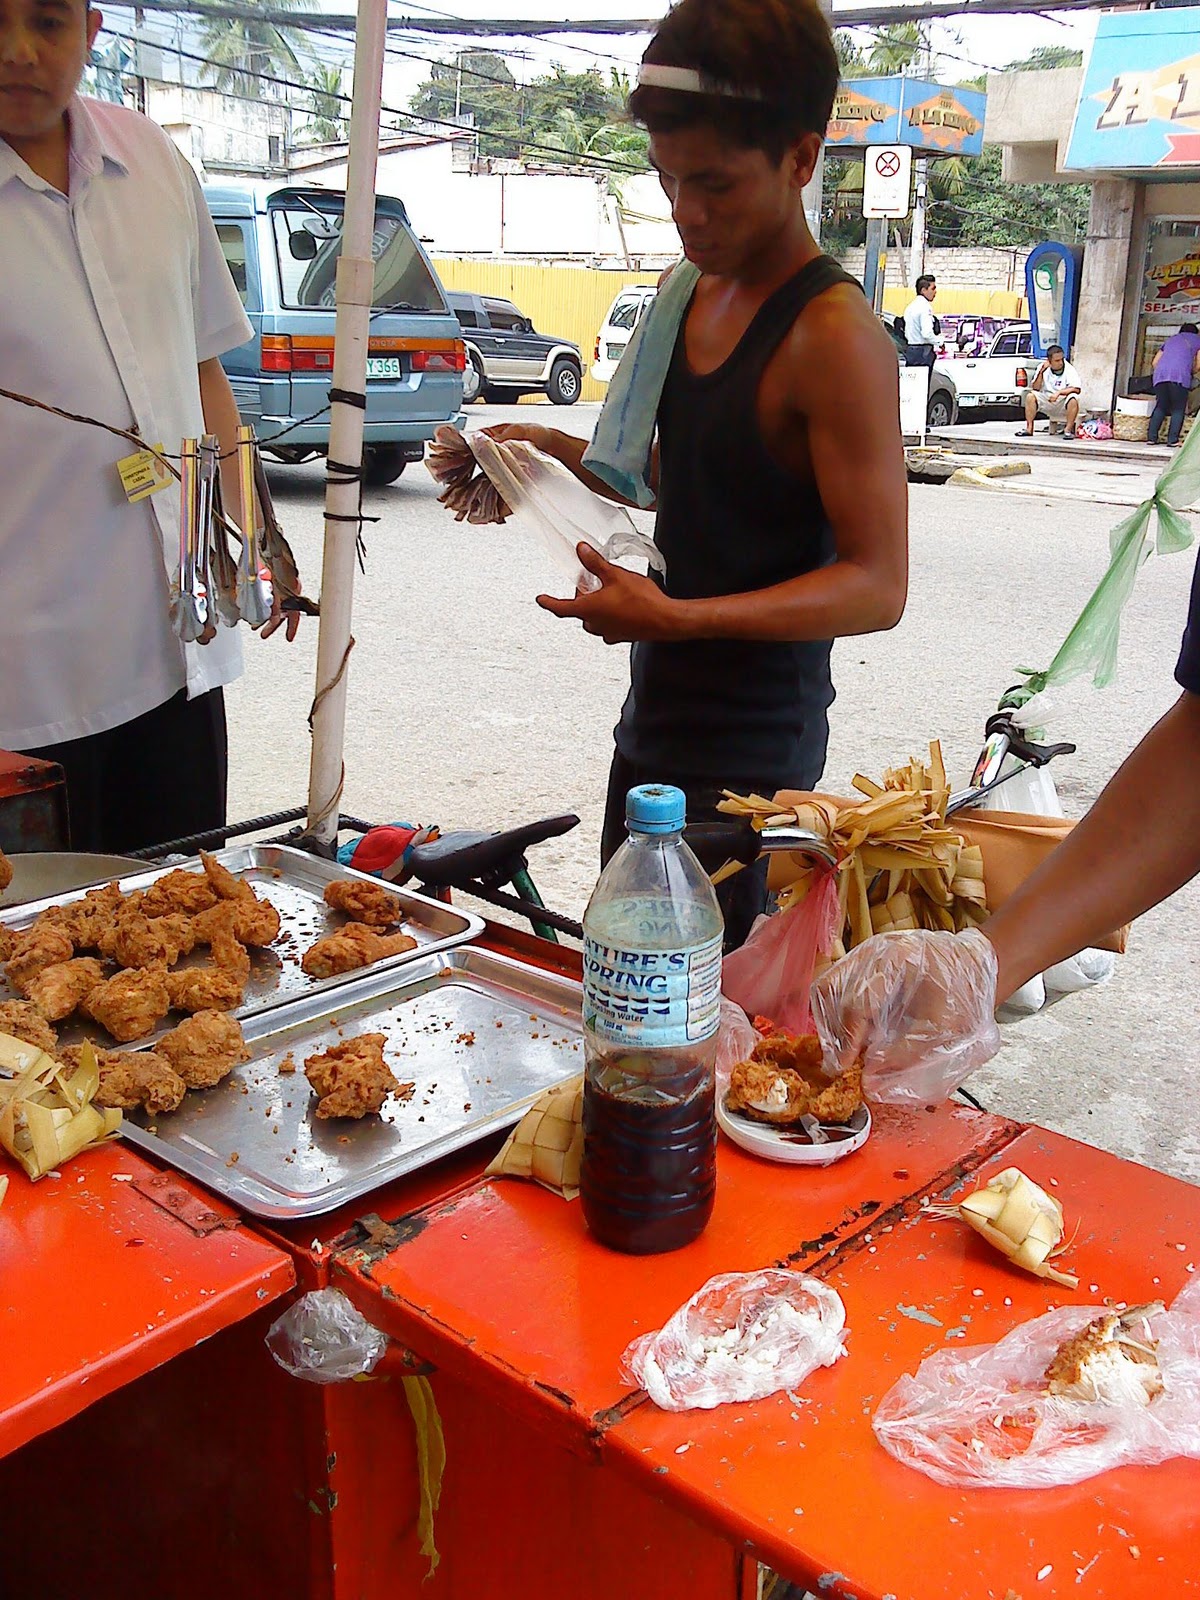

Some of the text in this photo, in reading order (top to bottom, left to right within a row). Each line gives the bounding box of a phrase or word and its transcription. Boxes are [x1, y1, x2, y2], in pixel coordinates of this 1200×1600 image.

[1096, 69, 1200, 130] A L
[909, 107, 920, 127] A
[1144, 302, 1200, 314] SELF-SE
[369, 339, 397, 348] OYOTA
[376, 360, 399, 373] 366
[585, 936, 686, 971] ATURE'S
[617, 1011, 645, 1023] Water
